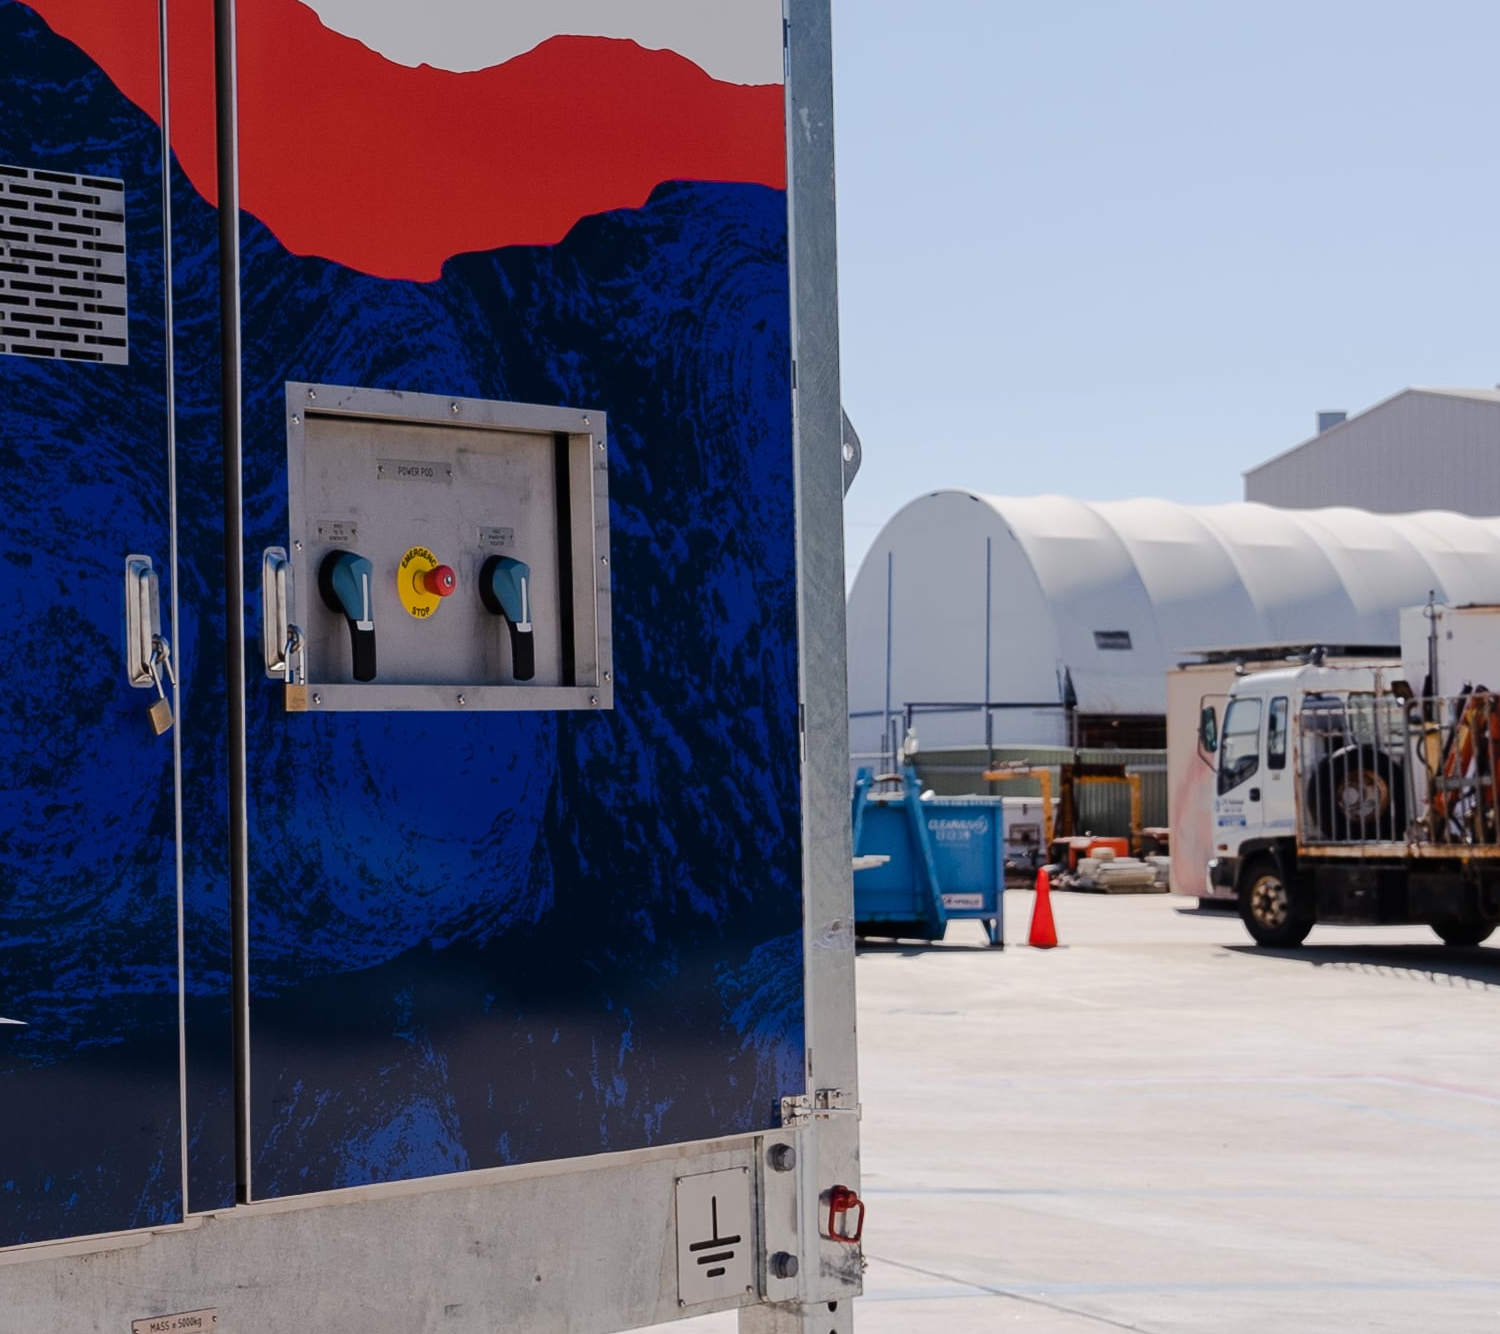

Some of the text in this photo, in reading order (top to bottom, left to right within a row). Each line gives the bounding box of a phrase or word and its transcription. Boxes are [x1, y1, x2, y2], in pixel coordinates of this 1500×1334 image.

[397, 466, 434, 478] POWER POD
[401, 548, 437, 569] EMERGENC
[412, 606, 430, 617] STOP
[149, 1320, 170, 1332] MASS
[177, 1316, 202, 1330] 5000kg
